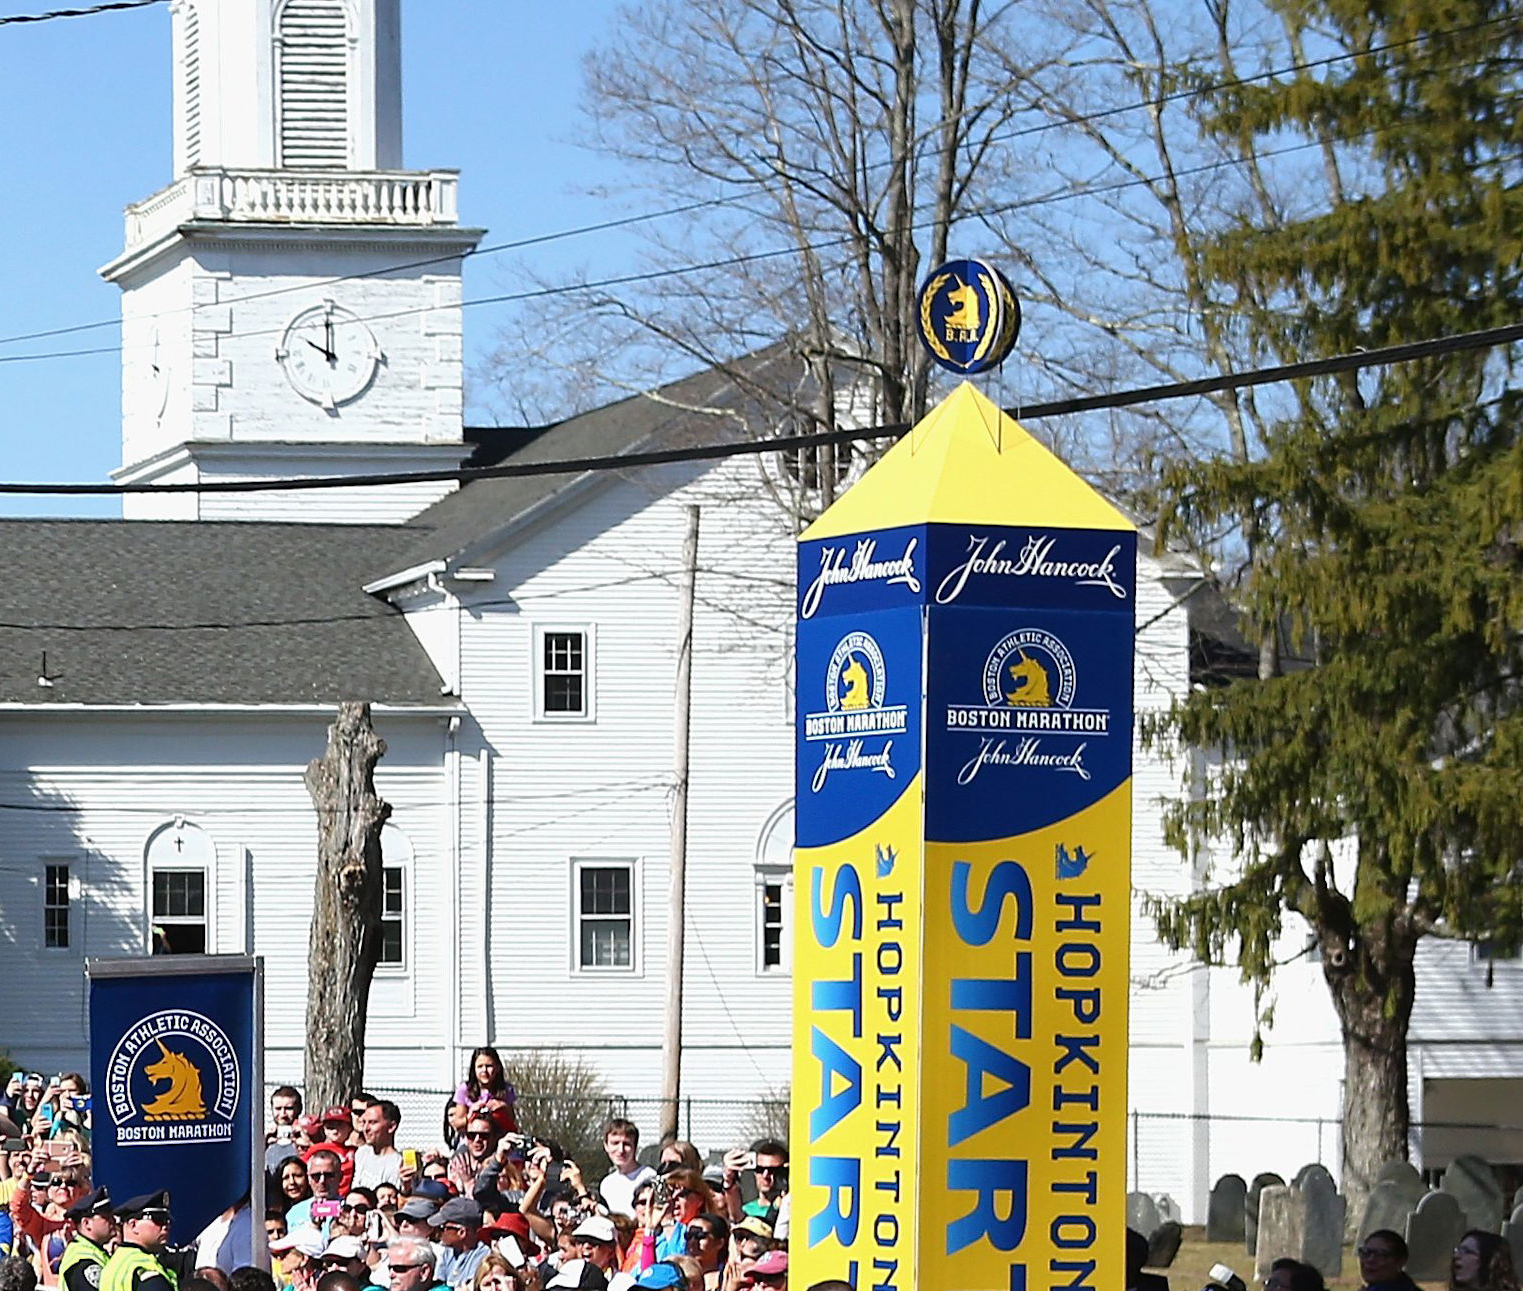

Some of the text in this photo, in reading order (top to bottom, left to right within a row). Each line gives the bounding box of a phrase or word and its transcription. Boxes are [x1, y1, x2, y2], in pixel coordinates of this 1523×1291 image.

[802, 537, 921, 620] John Hancock
[936, 535, 1127, 604] John Hancock
[987, 634, 1074, 703] BOSTON ATHLETIC ASSOCIATION
[805, 710, 907, 736] BOSTON MARATHON
[947, 709, 1109, 731] BOSTON MARATHON
[811, 740, 896, 793] John Hancock
[957, 738, 1092, 786] John Hancock
[111, 1014, 236, 1116] BOSTON ATHLETIC ASSOCIATION
[117, 1123, 232, 1141] BOSTON MARATHON
